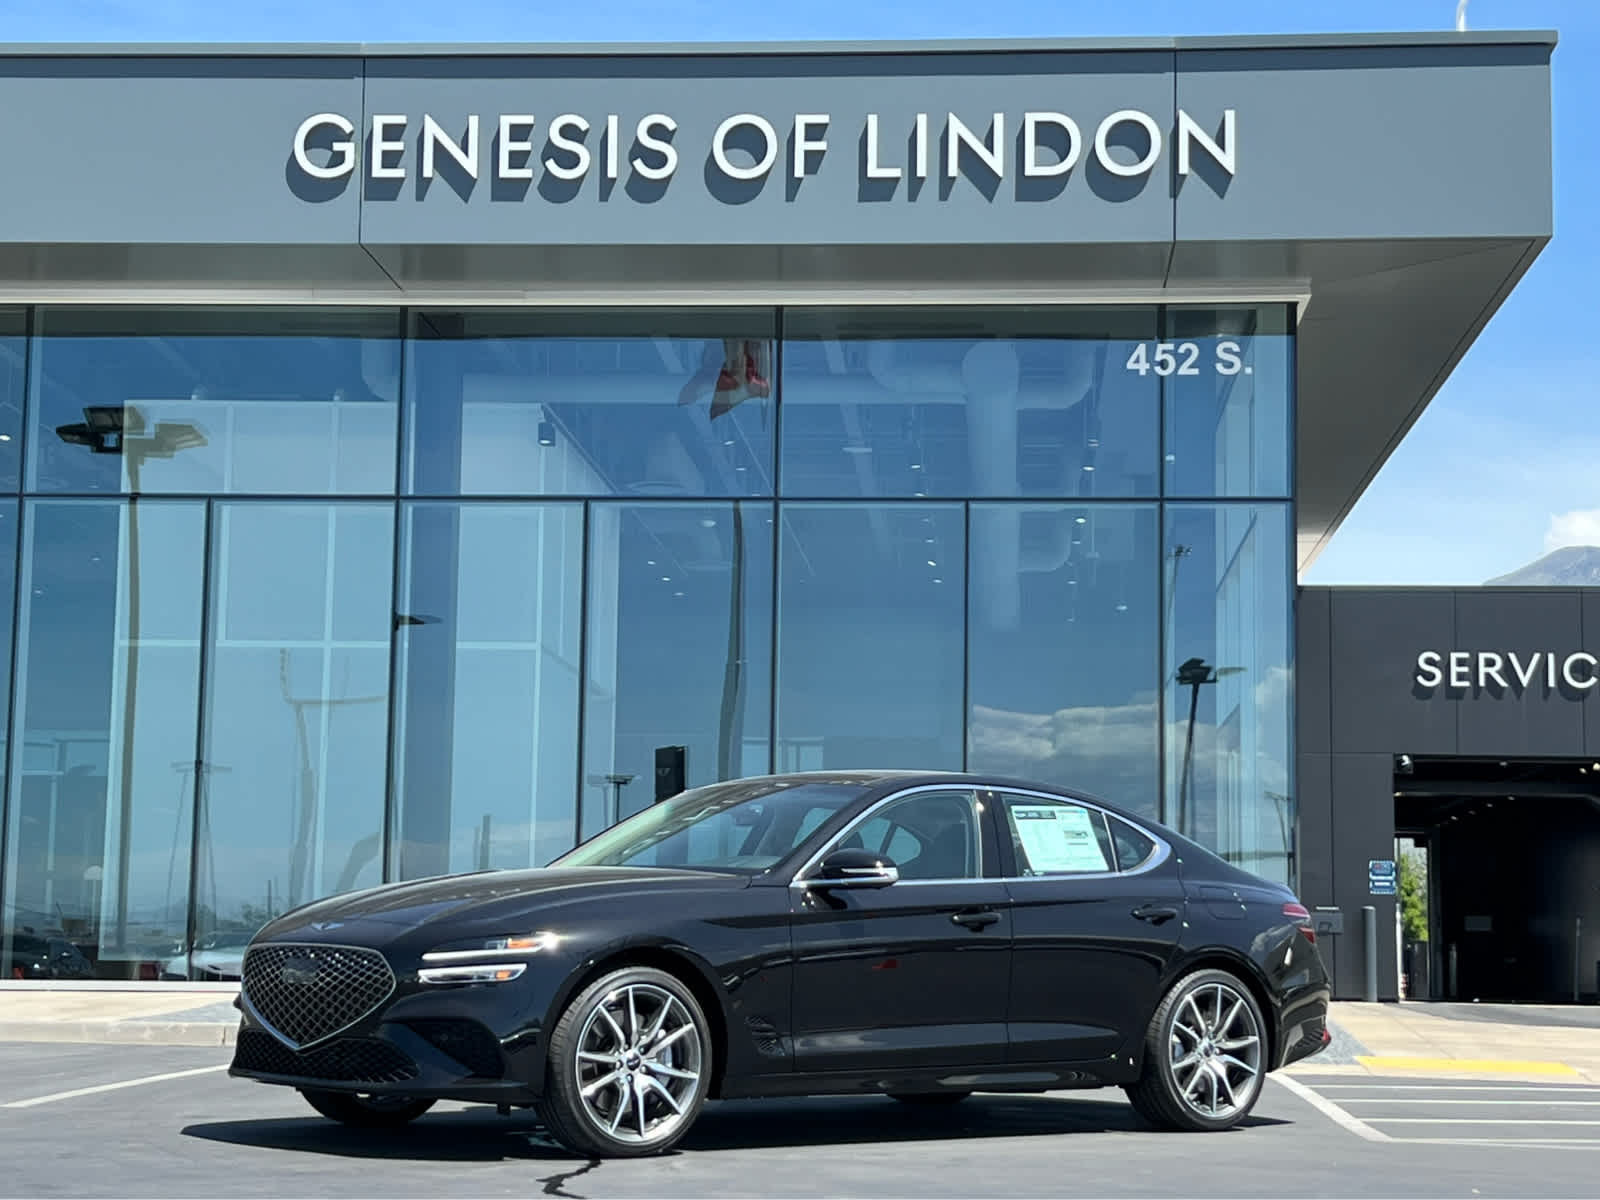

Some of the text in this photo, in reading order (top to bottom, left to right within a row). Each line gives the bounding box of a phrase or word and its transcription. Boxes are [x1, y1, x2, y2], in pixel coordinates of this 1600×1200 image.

[293, 109, 1236, 180] GENESIS OF LINDON
[1126, 341, 1253, 376] 452 S.
[1416, 651, 1599, 689] SERVIC
